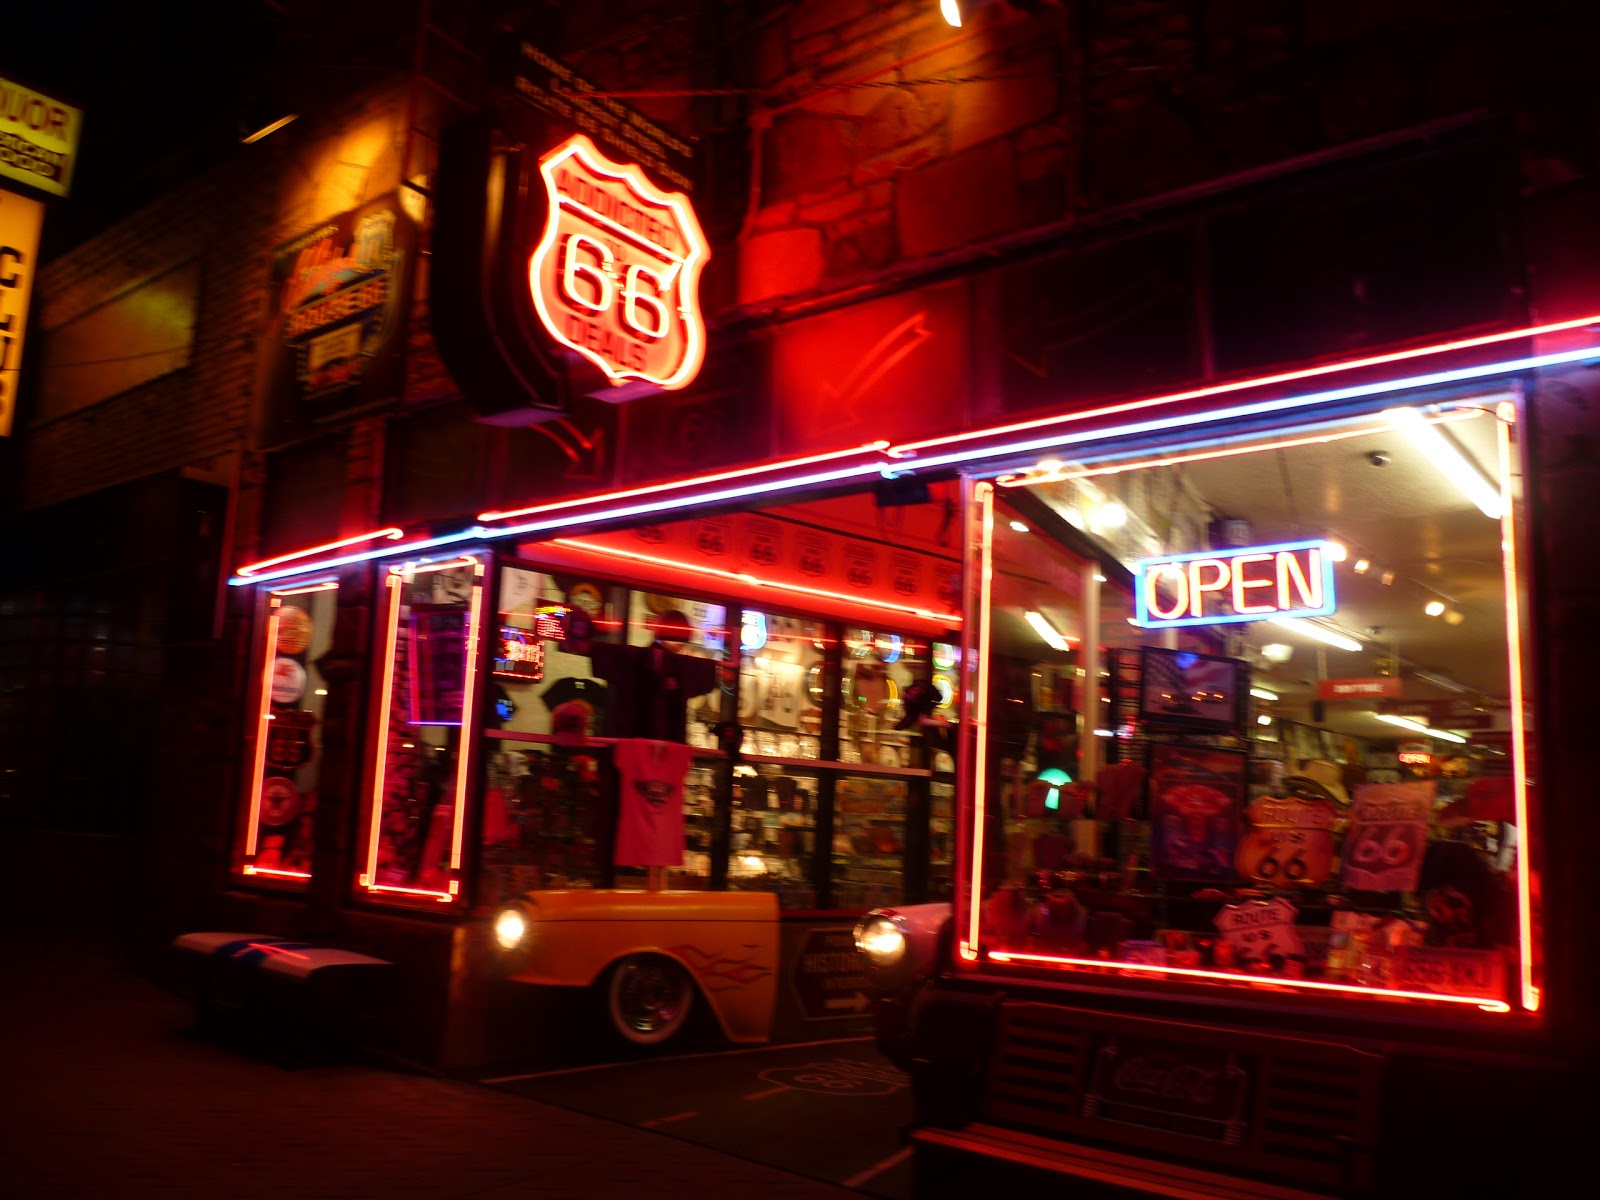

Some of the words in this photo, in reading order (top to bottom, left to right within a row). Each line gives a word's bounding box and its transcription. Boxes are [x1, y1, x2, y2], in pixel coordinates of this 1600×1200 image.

[559, 232, 684, 344] 66
[565, 313, 649, 374] DEALS
[1145, 547, 1324, 621] OPEN
[1399, 753, 1431, 765] OPEN
[1258, 845, 1308, 881] 66
[1355, 826, 1412, 866] 66
[1230, 908, 1282, 926] ROUTE
